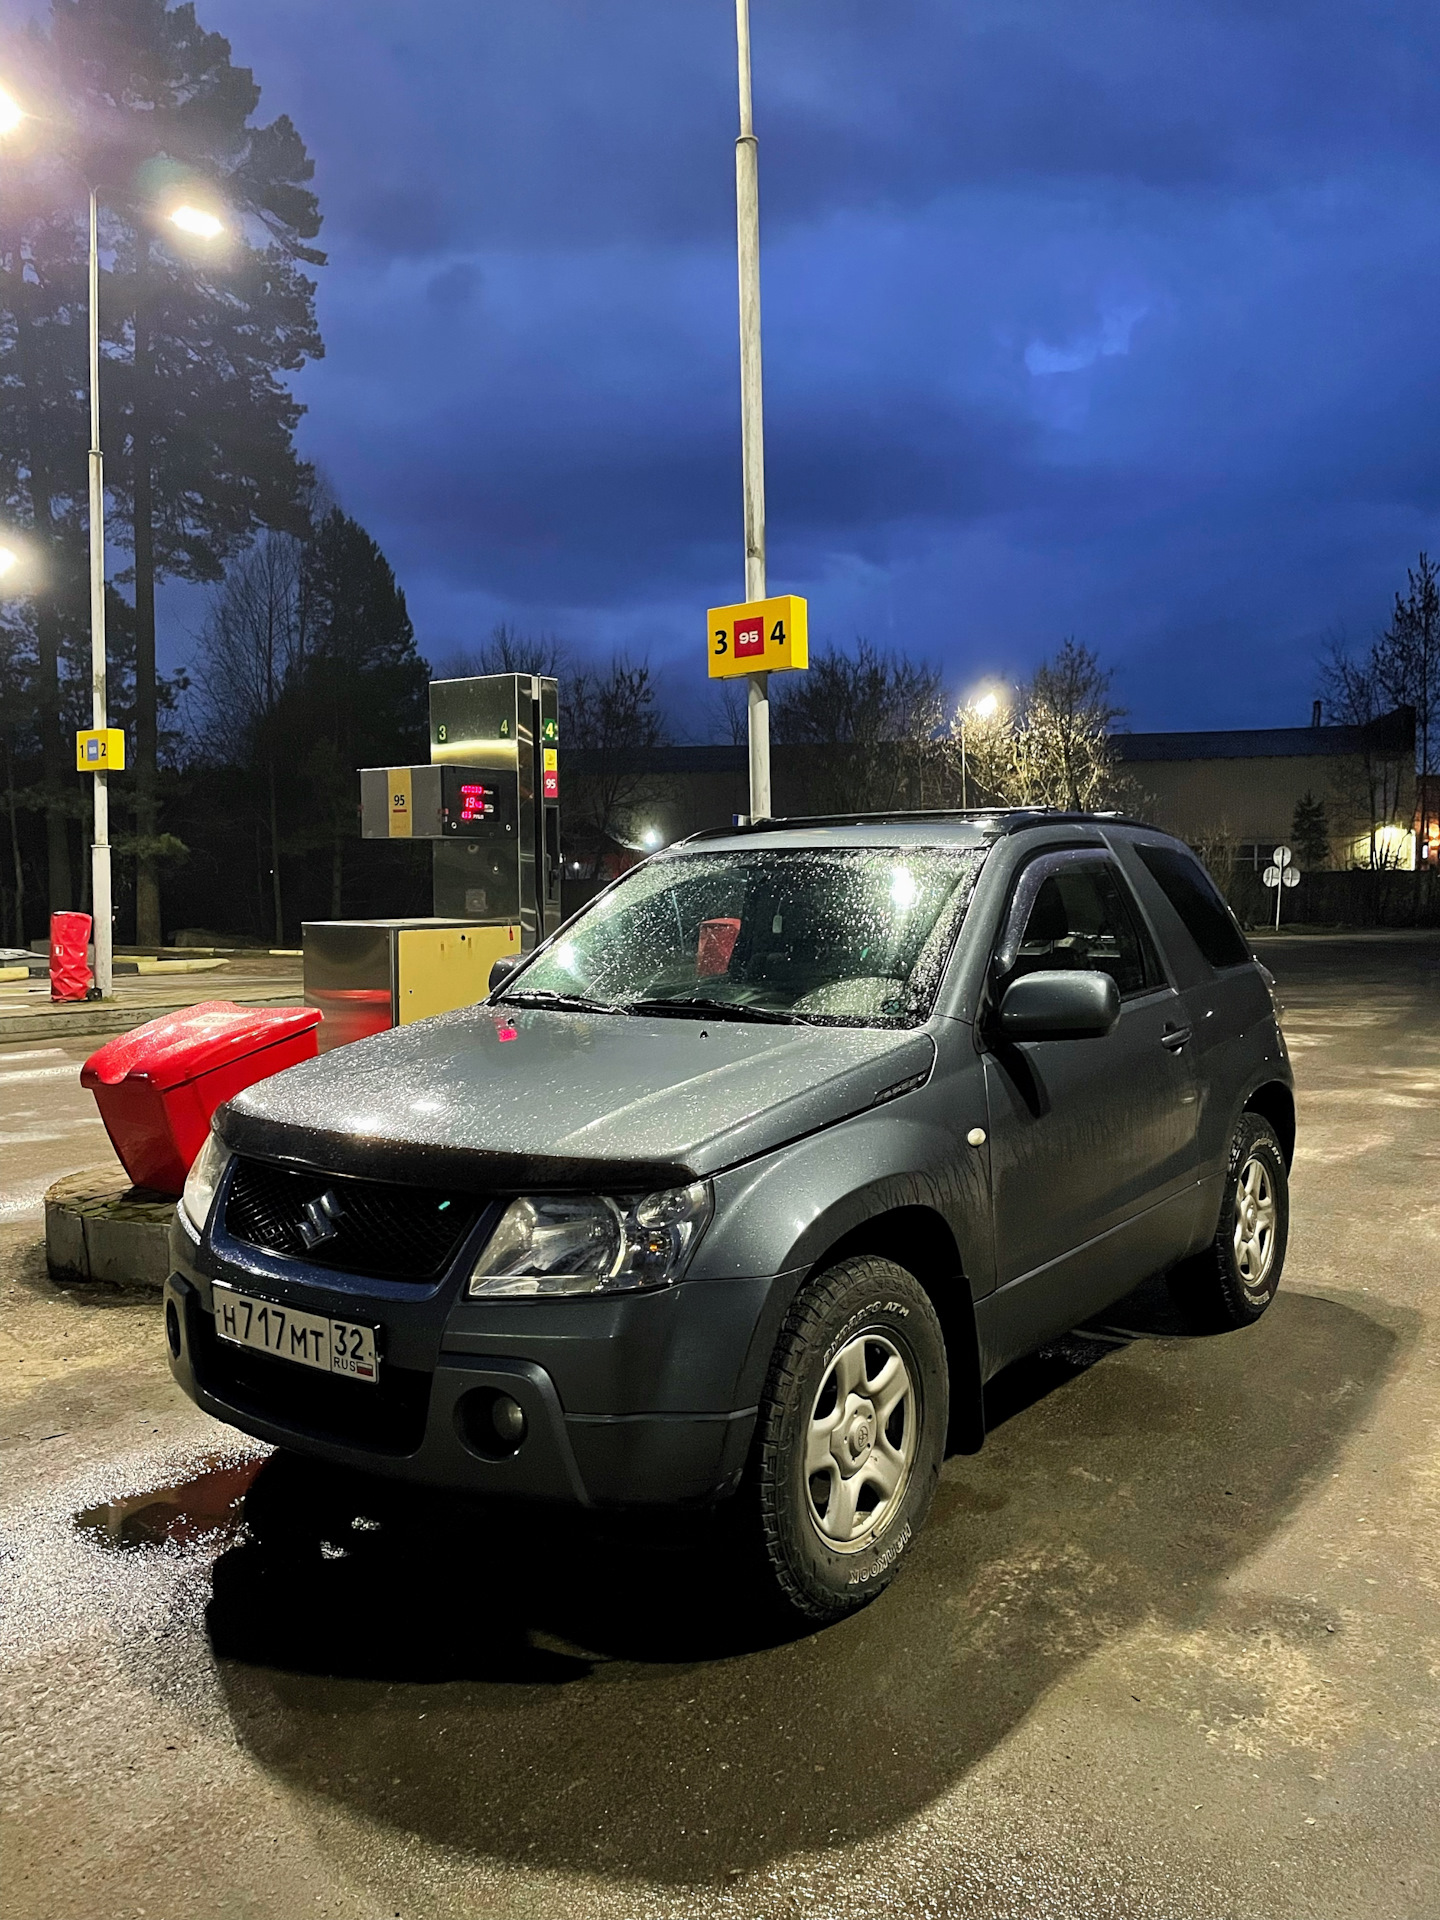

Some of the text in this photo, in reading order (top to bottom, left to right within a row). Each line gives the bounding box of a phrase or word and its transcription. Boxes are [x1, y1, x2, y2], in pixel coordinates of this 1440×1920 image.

[714, 620, 786, 655] 3 95 4
[439, 719, 509, 740] 3 4
[545, 722, 554, 738] 4
[80, 744, 84, 758] 1
[101, 742, 107, 757] 2
[545, 778, 556, 789] 95
[394, 794, 405, 806] 95
[334, 1324, 364, 1361] 32
[334, 1356, 355, 1372] RUS
